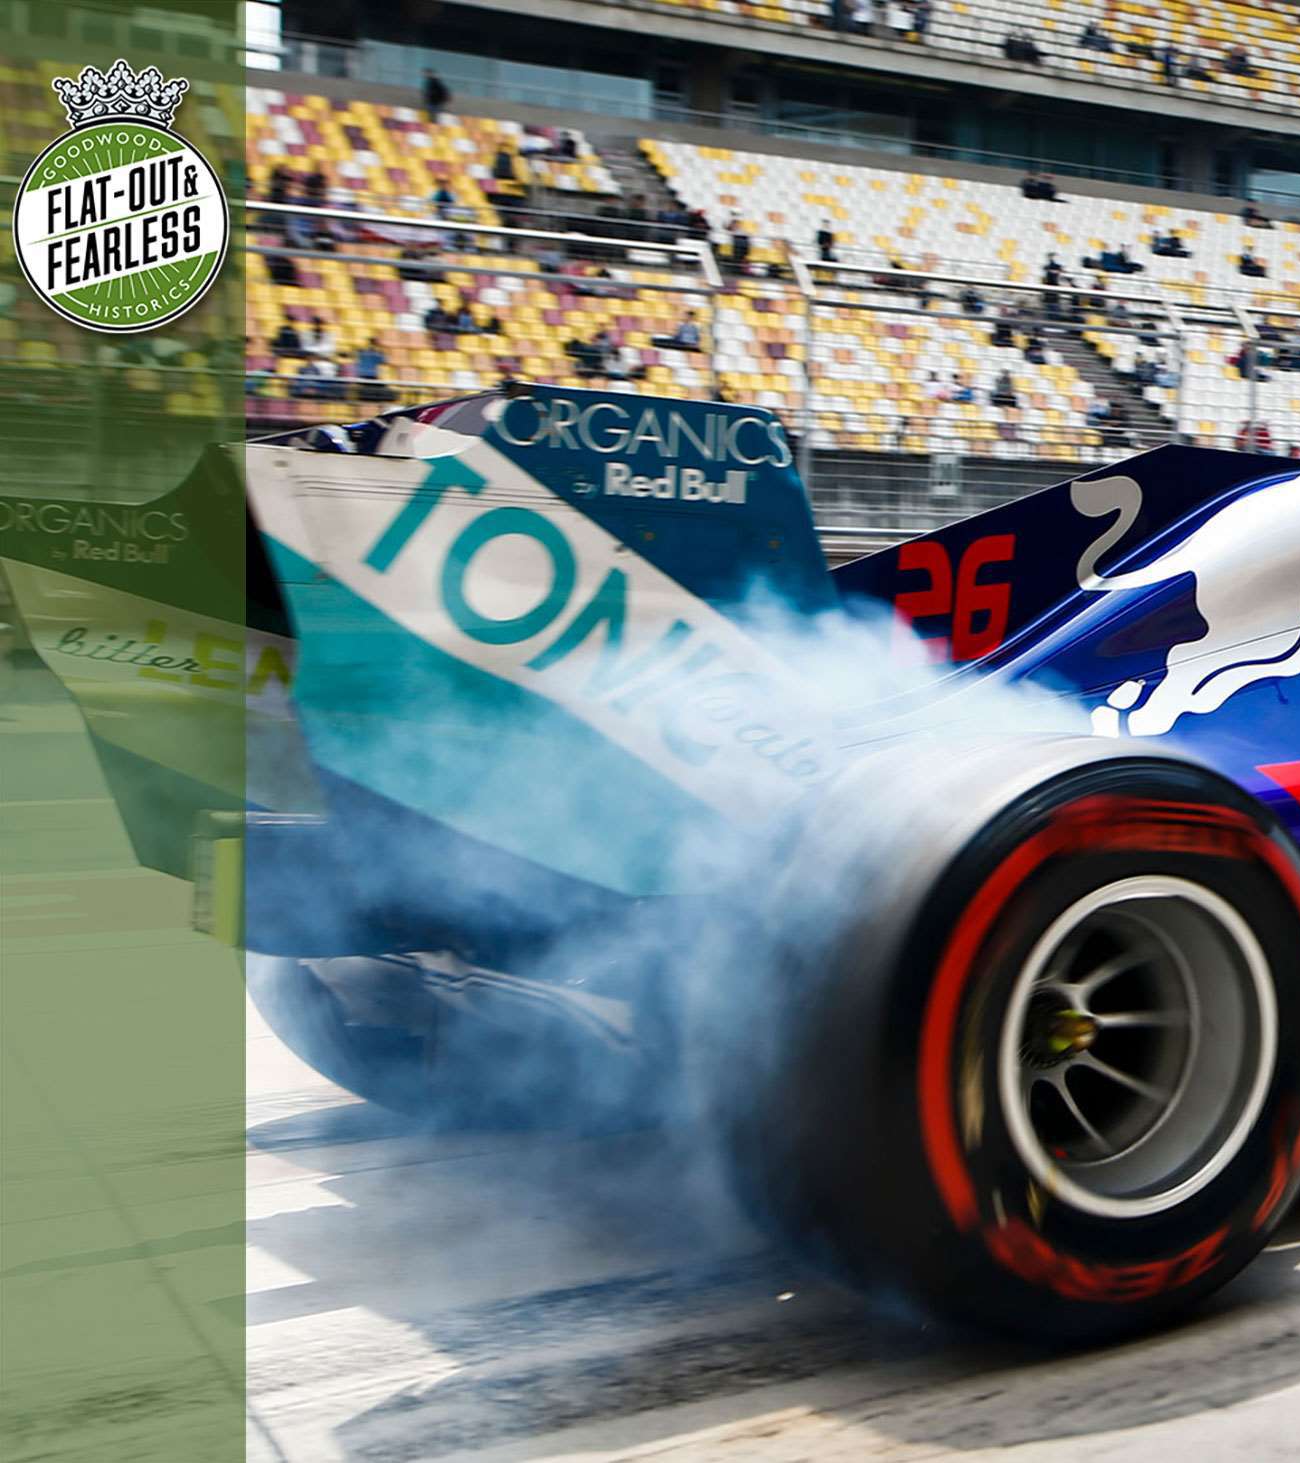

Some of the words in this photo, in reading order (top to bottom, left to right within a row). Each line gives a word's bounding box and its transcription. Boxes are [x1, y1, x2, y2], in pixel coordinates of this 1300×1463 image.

[493, 396, 793, 467] ORGANICS
[895, 534, 1016, 662] 26
[46, 627, 203, 673] bitter
